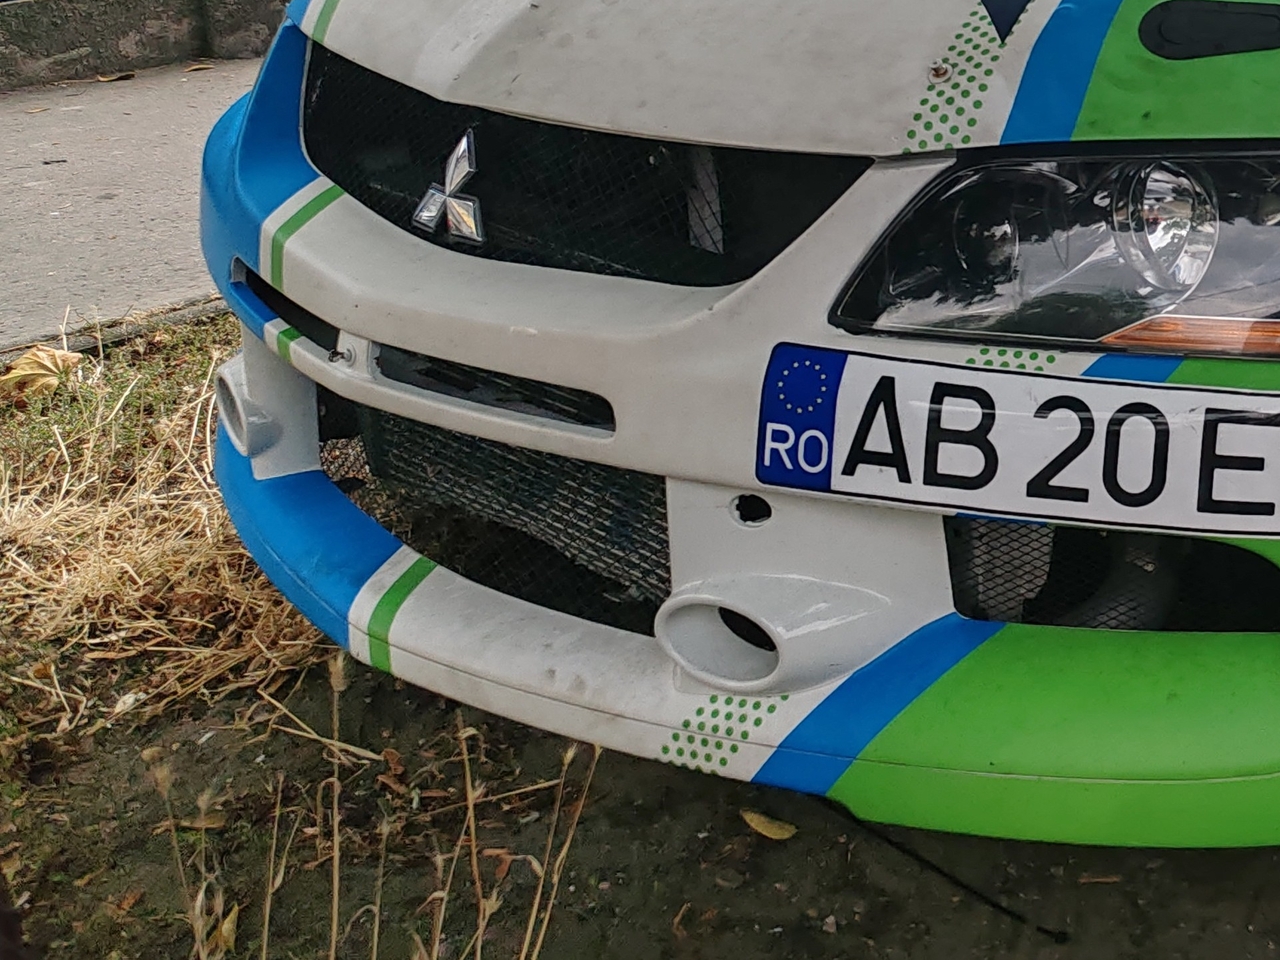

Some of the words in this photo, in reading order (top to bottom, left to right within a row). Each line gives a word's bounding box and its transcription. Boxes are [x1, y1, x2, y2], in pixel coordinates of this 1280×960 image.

[762, 421, 829, 474] RO
[840, 376, 999, 490] AB
[1026, 395, 1170, 508] 20
